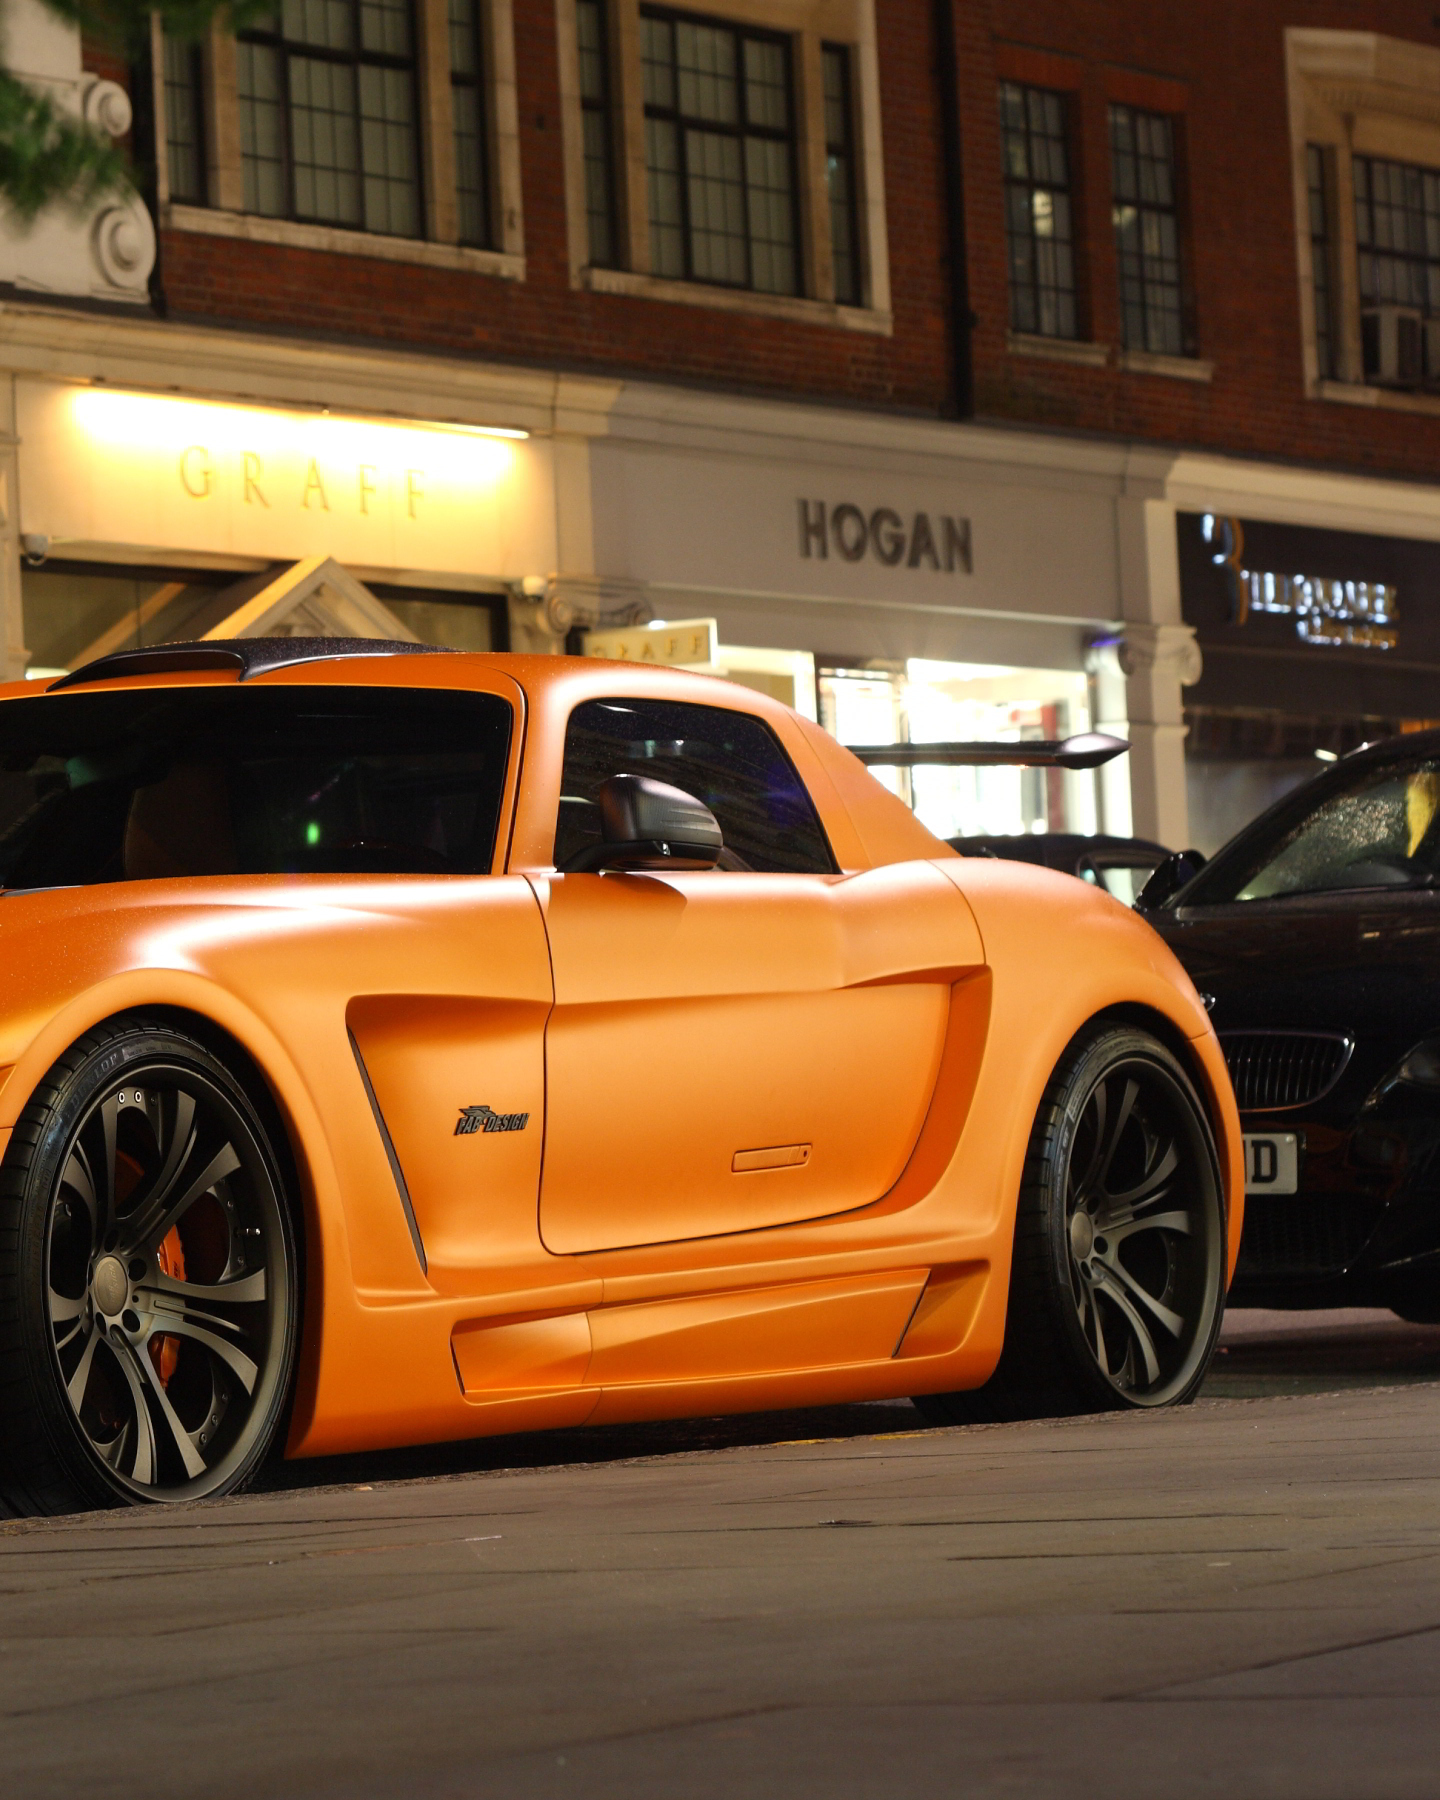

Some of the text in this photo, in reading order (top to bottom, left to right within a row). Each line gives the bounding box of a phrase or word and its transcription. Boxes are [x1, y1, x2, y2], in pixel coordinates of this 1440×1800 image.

[179, 445, 425, 519] GRAFF
[796, 498, 973, 575] HOGAN
[454, 1113, 529, 1135] FAB DESIGN
